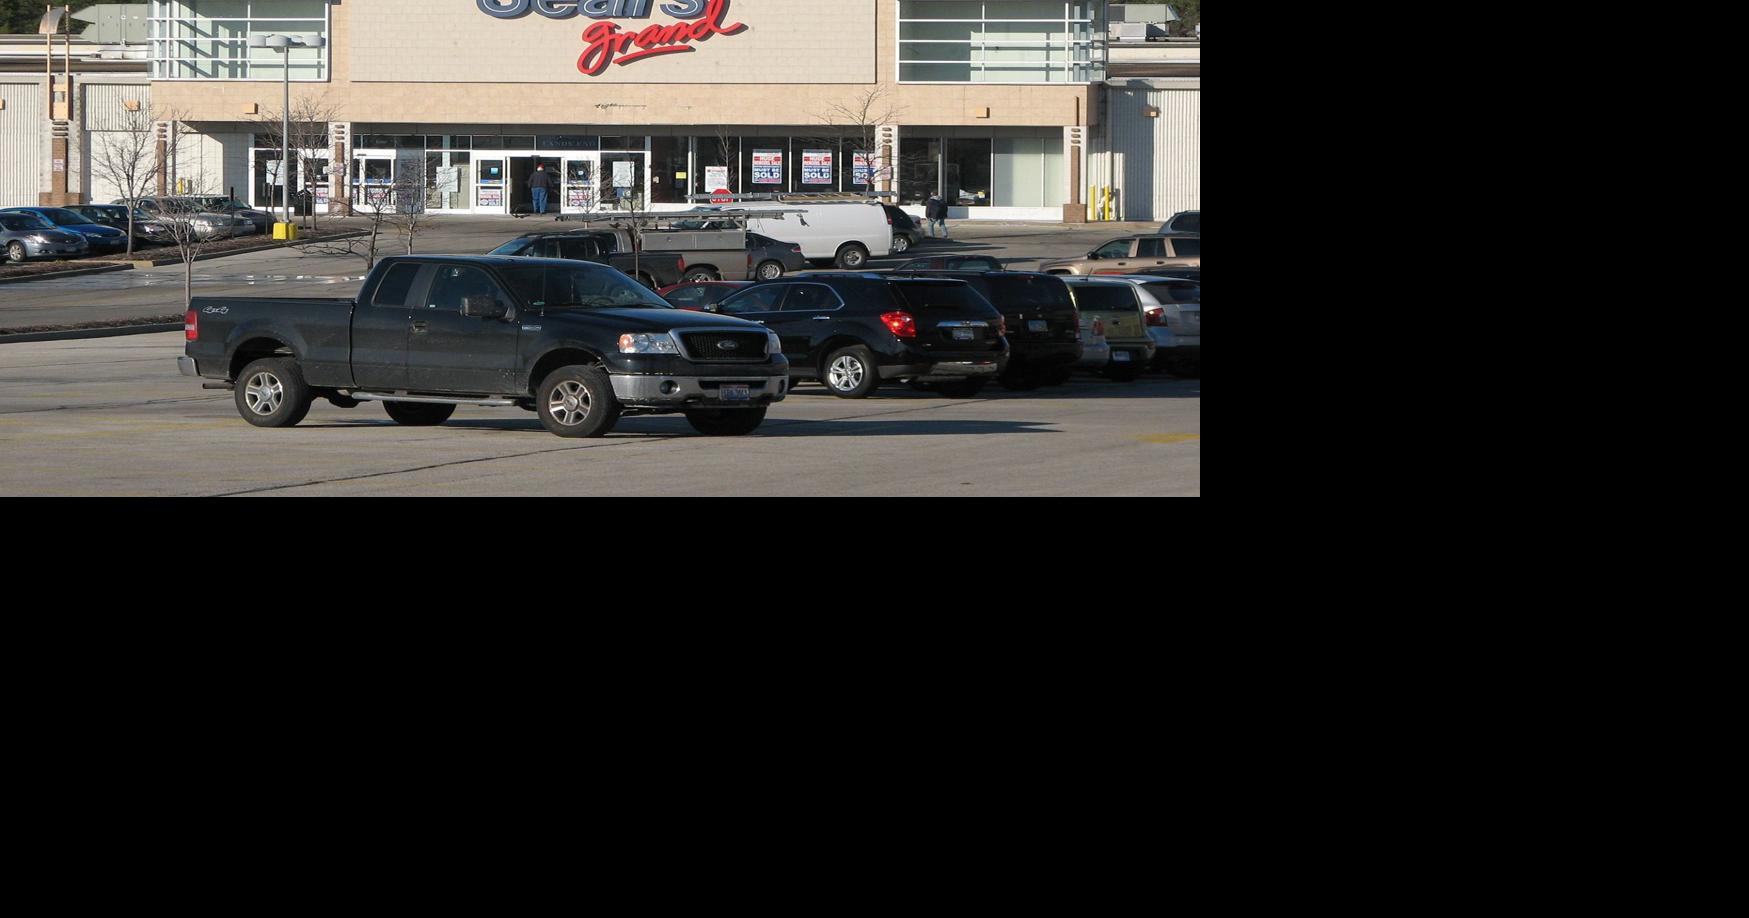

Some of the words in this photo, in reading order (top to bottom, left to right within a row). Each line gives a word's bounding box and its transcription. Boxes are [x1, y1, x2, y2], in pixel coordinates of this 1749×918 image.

[577, 0, 748, 76] grand
[754, 171, 780, 179] SOLD
[804, 171, 830, 179] SOLD
